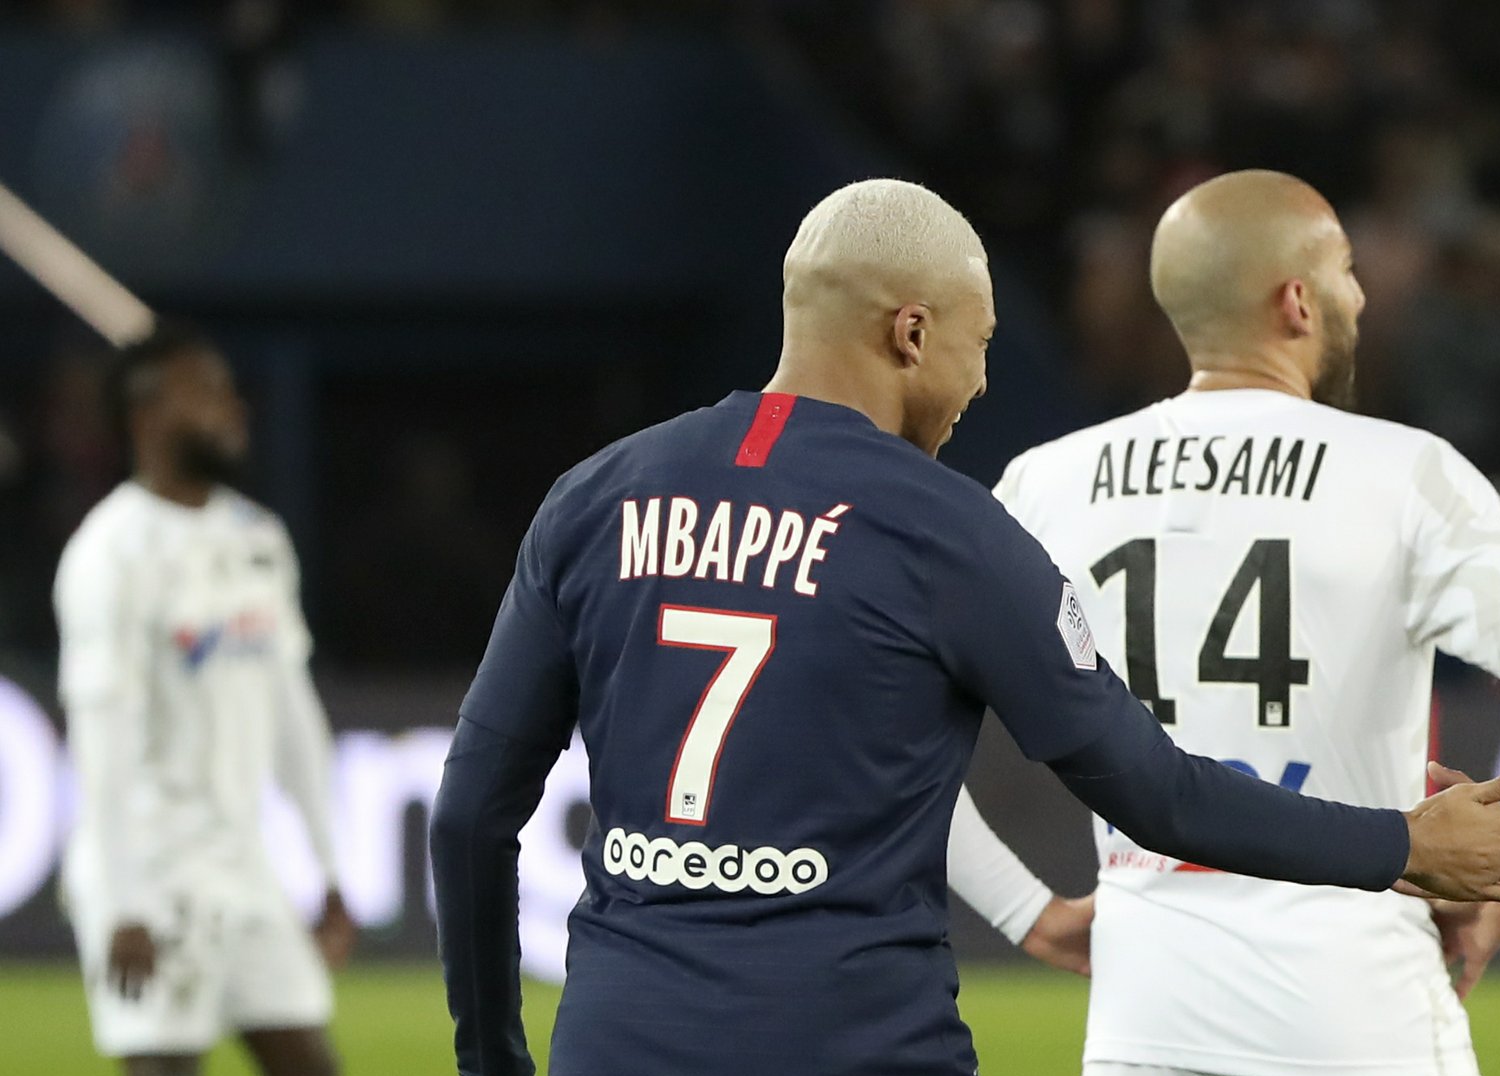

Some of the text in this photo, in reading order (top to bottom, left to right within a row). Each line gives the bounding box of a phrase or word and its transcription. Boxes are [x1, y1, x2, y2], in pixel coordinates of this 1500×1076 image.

[1091, 437, 1328, 504] ALEESAMI
[618, 497, 852, 597] MBAPPÉ
[1089, 537, 1310, 726] 14
[656, 603, 778, 826] 7
[603, 827, 829, 895] ooredoo
